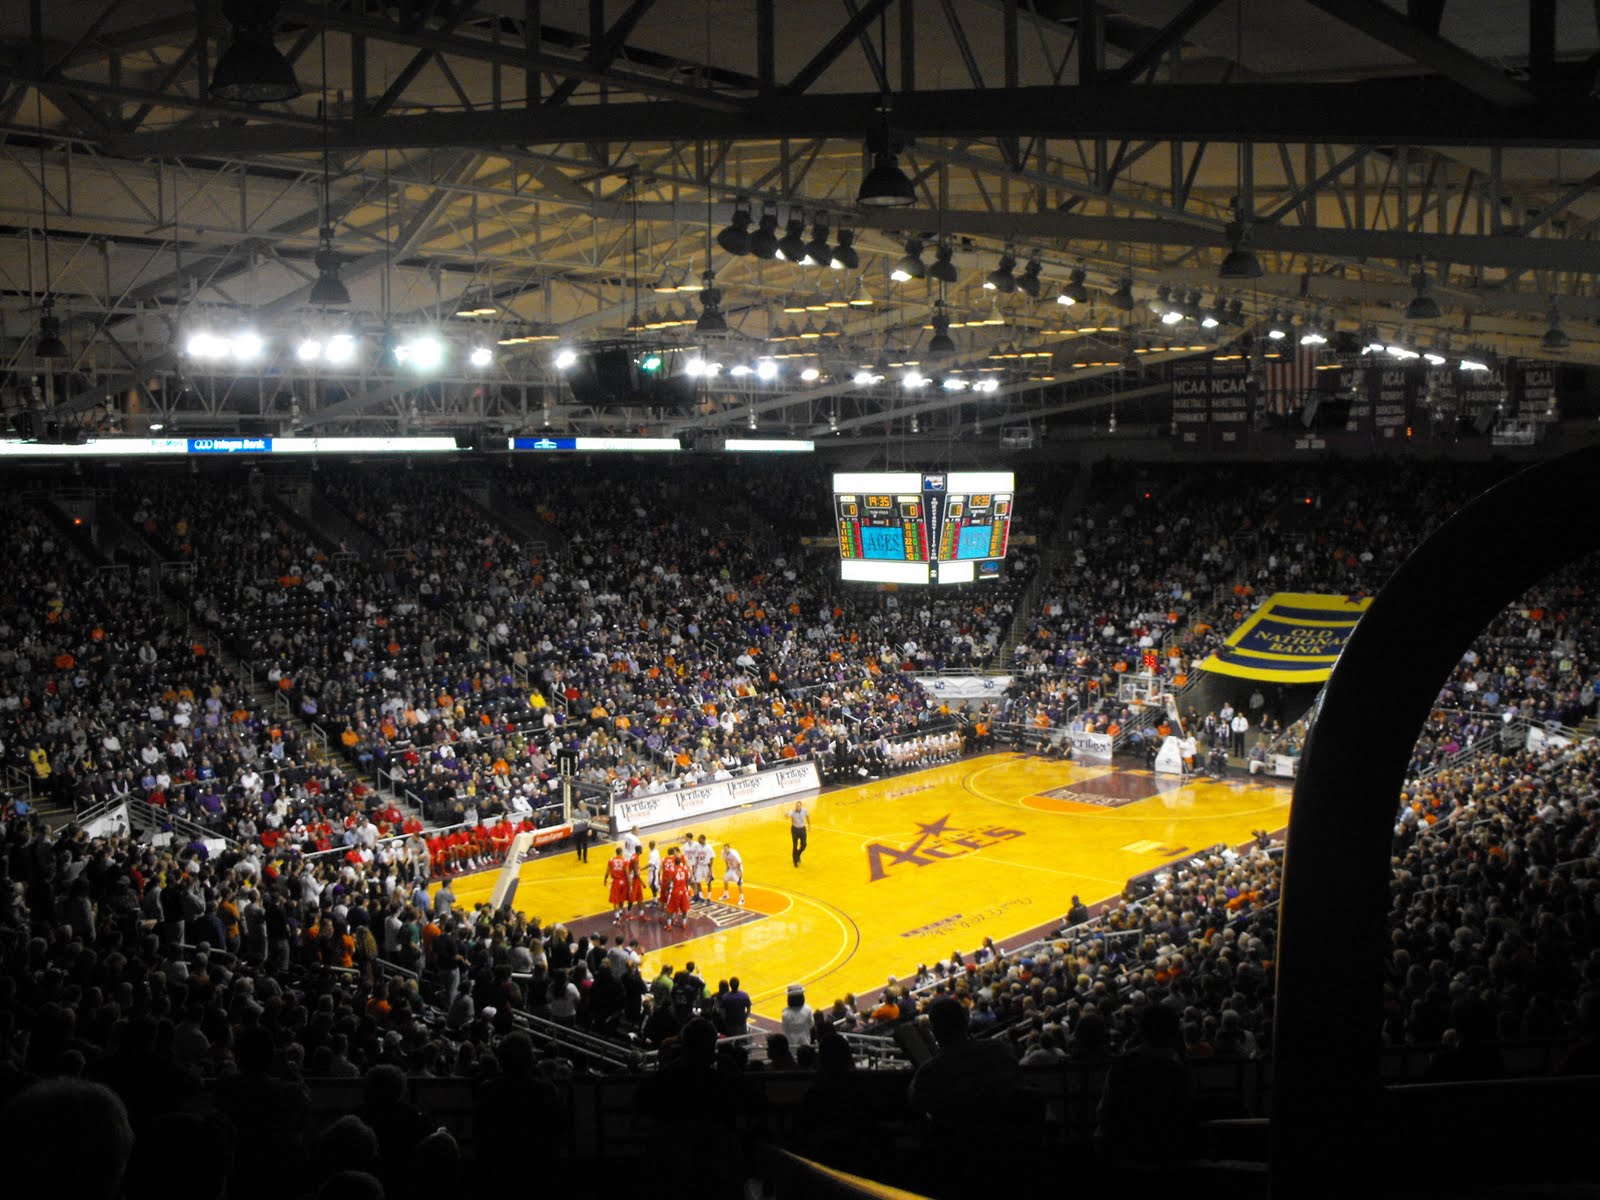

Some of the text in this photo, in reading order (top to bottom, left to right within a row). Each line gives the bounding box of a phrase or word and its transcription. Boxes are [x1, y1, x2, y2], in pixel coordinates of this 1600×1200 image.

[1381, 371, 1406, 385] NCAA
[1525, 371, 1552, 386] NCAA
[1173, 380, 1207, 394] NCAA
[1211, 378, 1247, 394] NCAA
[213, 439, 265, 451] Integra Bank
[868, 496, 890, 507] 19:35
[849, 504, 857, 515] 0
[909, 505, 917, 515] 0
[867, 532, 900, 552] ACES
[1291, 628, 1334, 638] OLD
[1268, 643, 1322, 655] BANK
[1144, 655, 1155, 666] 35
[1071, 736, 1111, 753] eritage
[776, 768, 809, 786] Heritage
[727, 777, 762, 796] Heritage
[676, 787, 713, 807] Heritage
[621, 799, 660, 819] Heritage
[866, 814, 1027, 883] ACES
[613, 861, 624, 871] 32
[675, 870, 686, 881] 43
